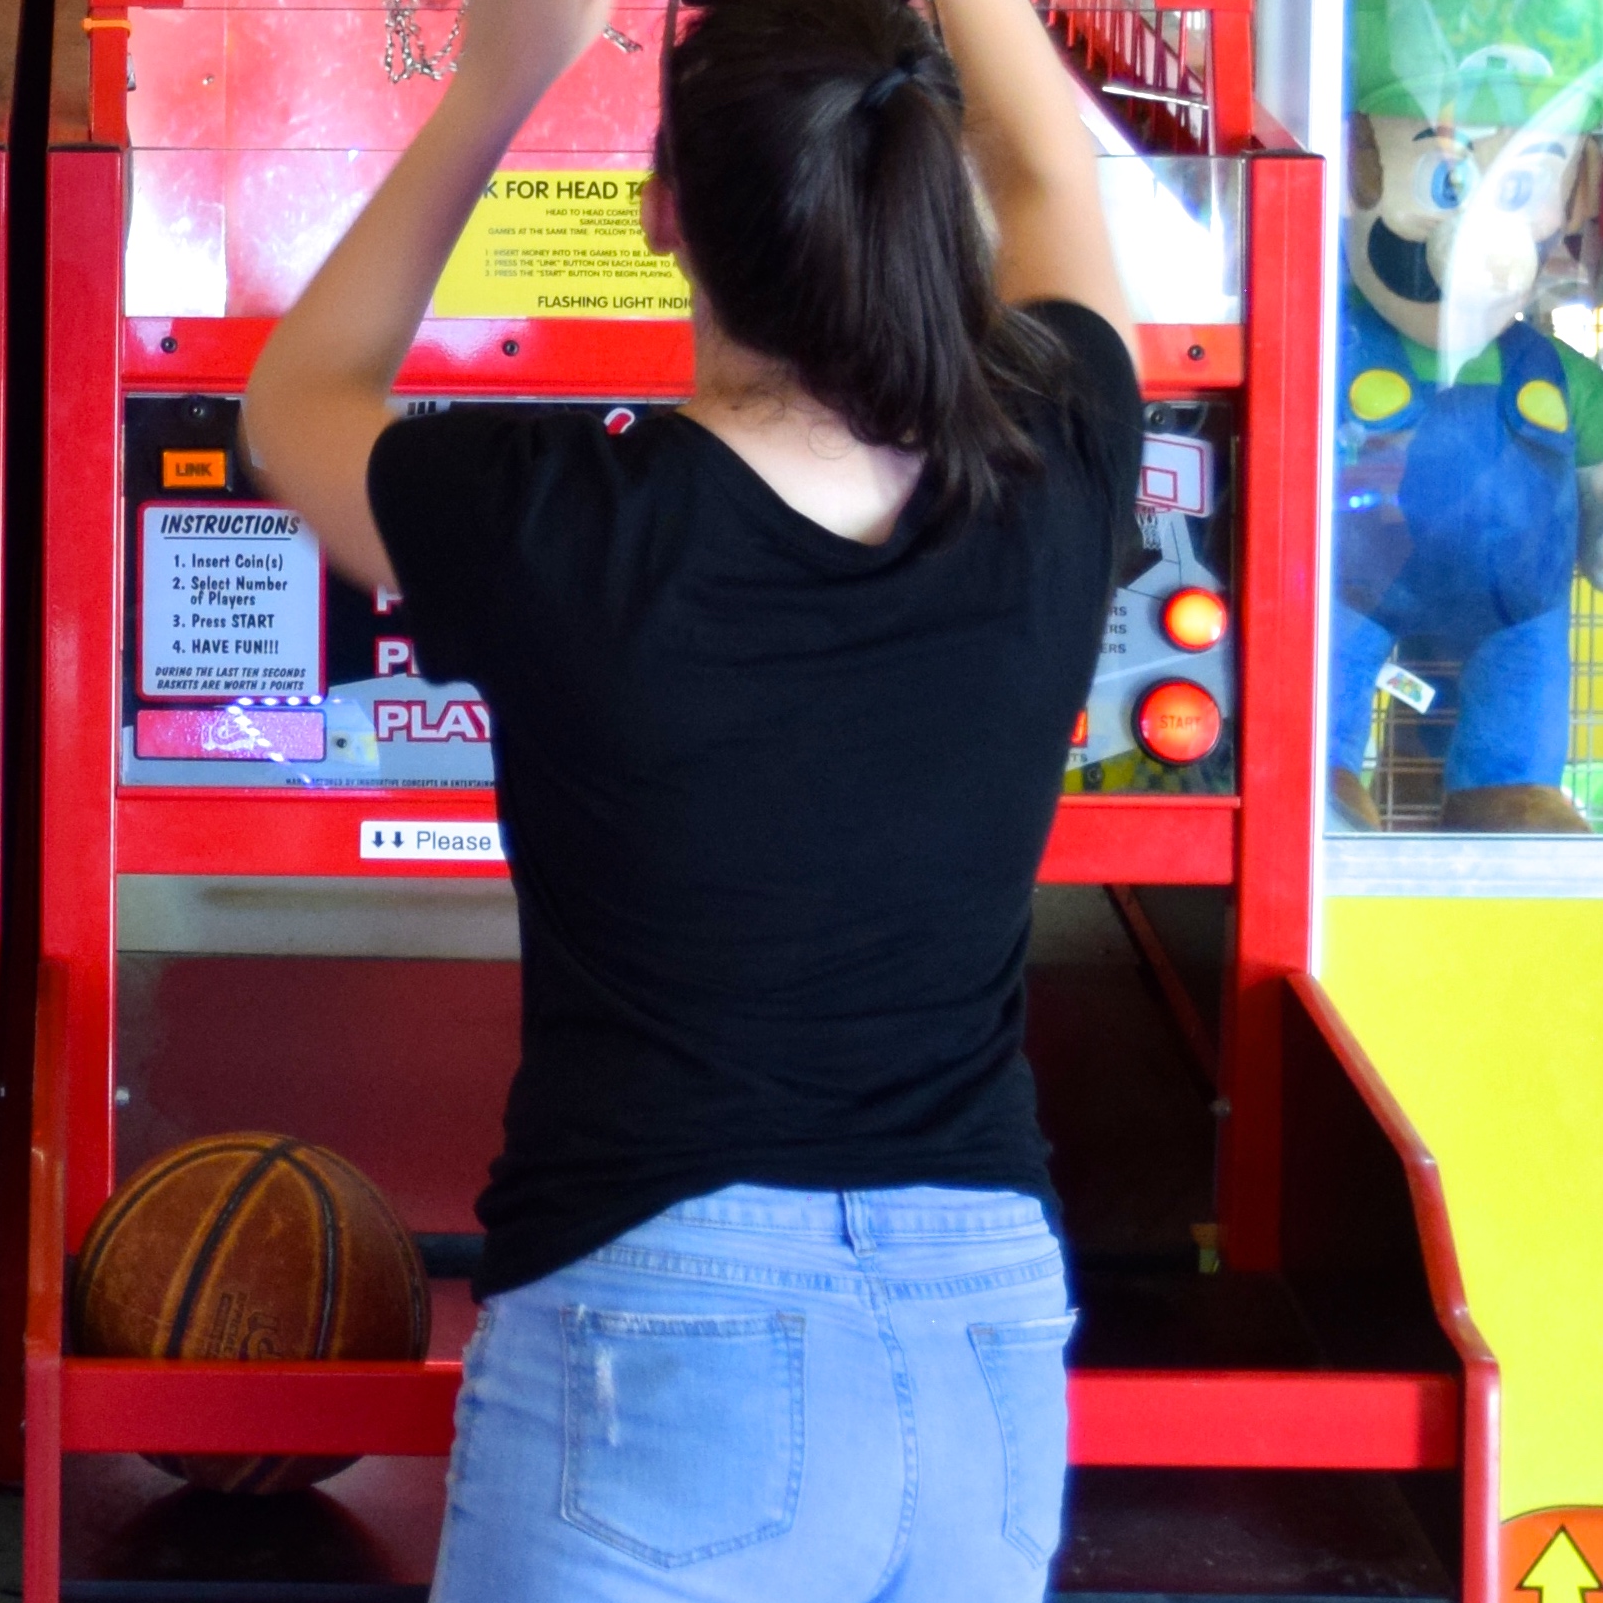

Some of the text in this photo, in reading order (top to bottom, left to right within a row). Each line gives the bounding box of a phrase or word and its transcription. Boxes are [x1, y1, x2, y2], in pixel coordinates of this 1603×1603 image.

[506, 181, 549, 199] FOR
[556, 181, 618, 199] HEAD
[594, 228, 626, 236] FOLLOW
[521, 249, 549, 257] MONEY
[552, 249, 571, 257] INTO
[520, 259, 533, 267] THE
[563, 259, 594, 267] BUTTON
[597, 259, 609, 267] ON
[634, 260, 657, 268] GAME
[520, 269, 533, 277] THE
[568, 269, 600, 277] BUTTON
[615, 270, 638, 278] BEGIN
[537, 296, 608, 309] FLASHING
[613, 296, 654, 309] LIGHT
[175, 463, 213, 477] LINK
[161, 514, 300, 535] INSTRUCTIONS
[174, 553, 283, 571] 1. Insert Coin(s)
[172, 575, 288, 591] 2. Select Number
[190, 590, 256, 610] of Players
[172, 613, 274, 629] 3. Press START
[172, 639, 279, 655] 4. HAVE FUN!!!
[155, 666, 306, 678] DURING THE LAST TEN SECONDS
[157, 680, 198, 690] BASKETS
[200, 680, 220, 690] ARE
[223, 680, 257, 690] WORTH
[269, 681, 304, 691] POINTS
[1160, 715, 1201, 729] START
[402, 779, 438, 787] CONCEPTS
[417, 830, 491, 851] Please
